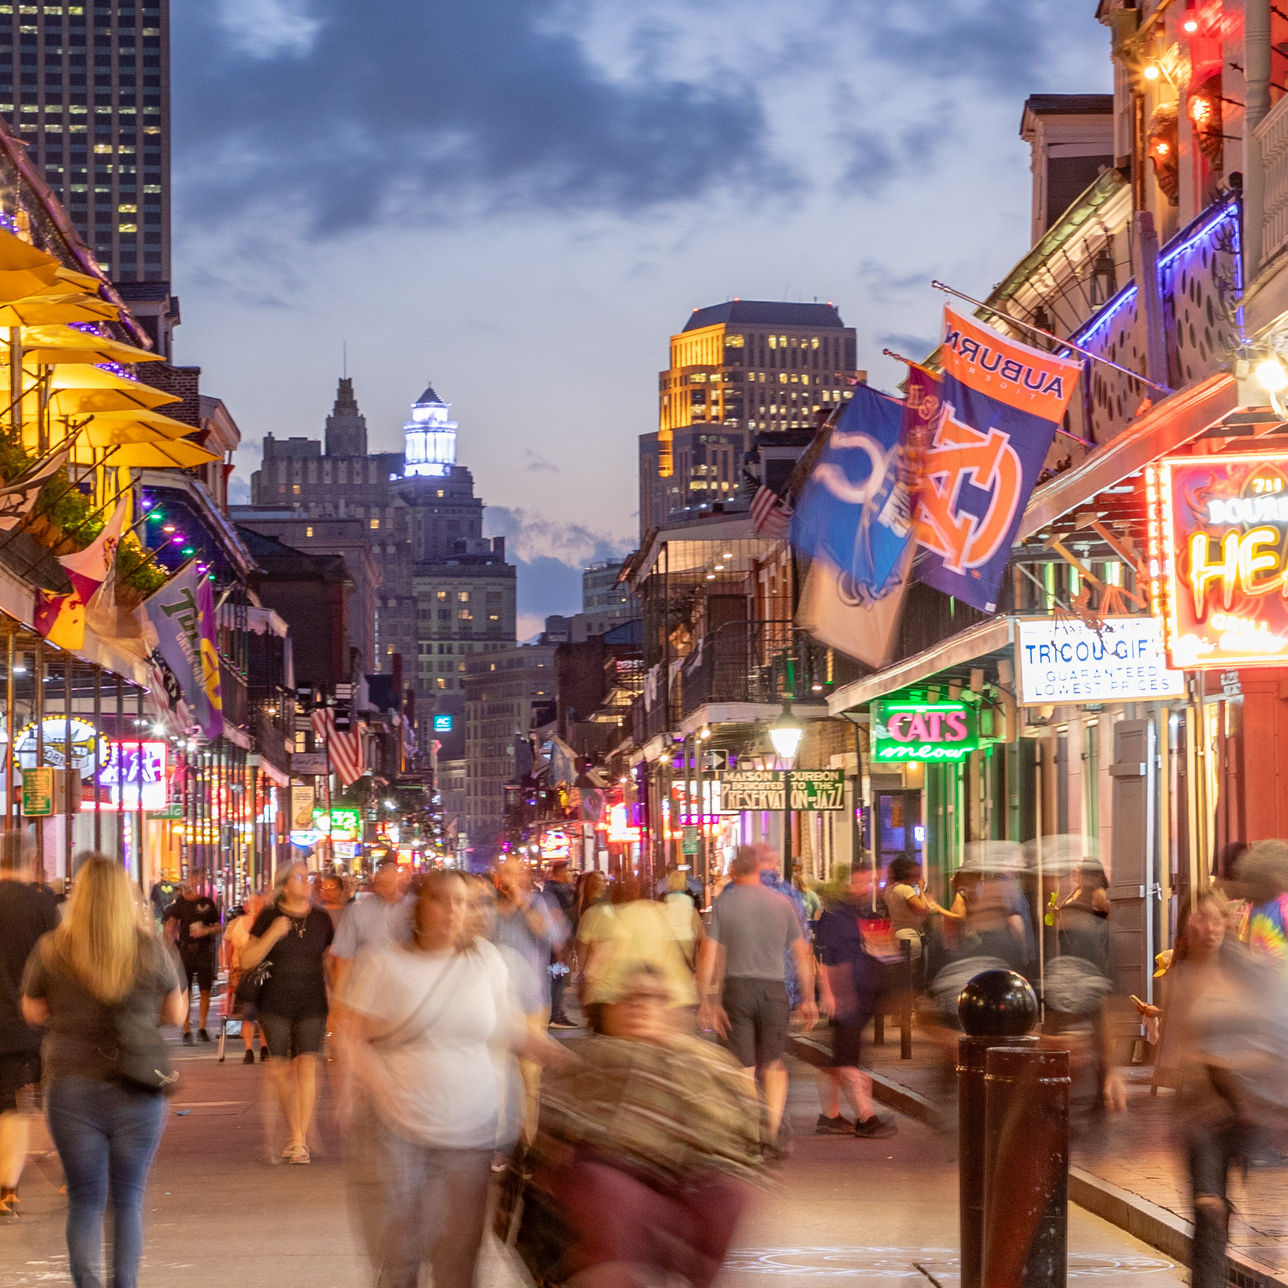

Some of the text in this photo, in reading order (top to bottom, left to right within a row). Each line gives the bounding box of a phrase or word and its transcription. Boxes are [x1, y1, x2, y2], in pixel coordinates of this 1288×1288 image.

[1253, 478, 1282, 493] 711
[1025, 639, 1160, 664] TRICOU GIF
[1045, 666, 1158, 682] GUARANTEED
[436, 717, 450, 725] AC
[887, 711, 968, 742] CATS
[879, 745, 975, 758] meow
[723, 772, 772, 781] MAISON
[732, 782, 833, 790] DEDICATED TO THE
[720, 784, 808, 810] PRESERVATON
[813, 784, 843, 810] JAZZ
